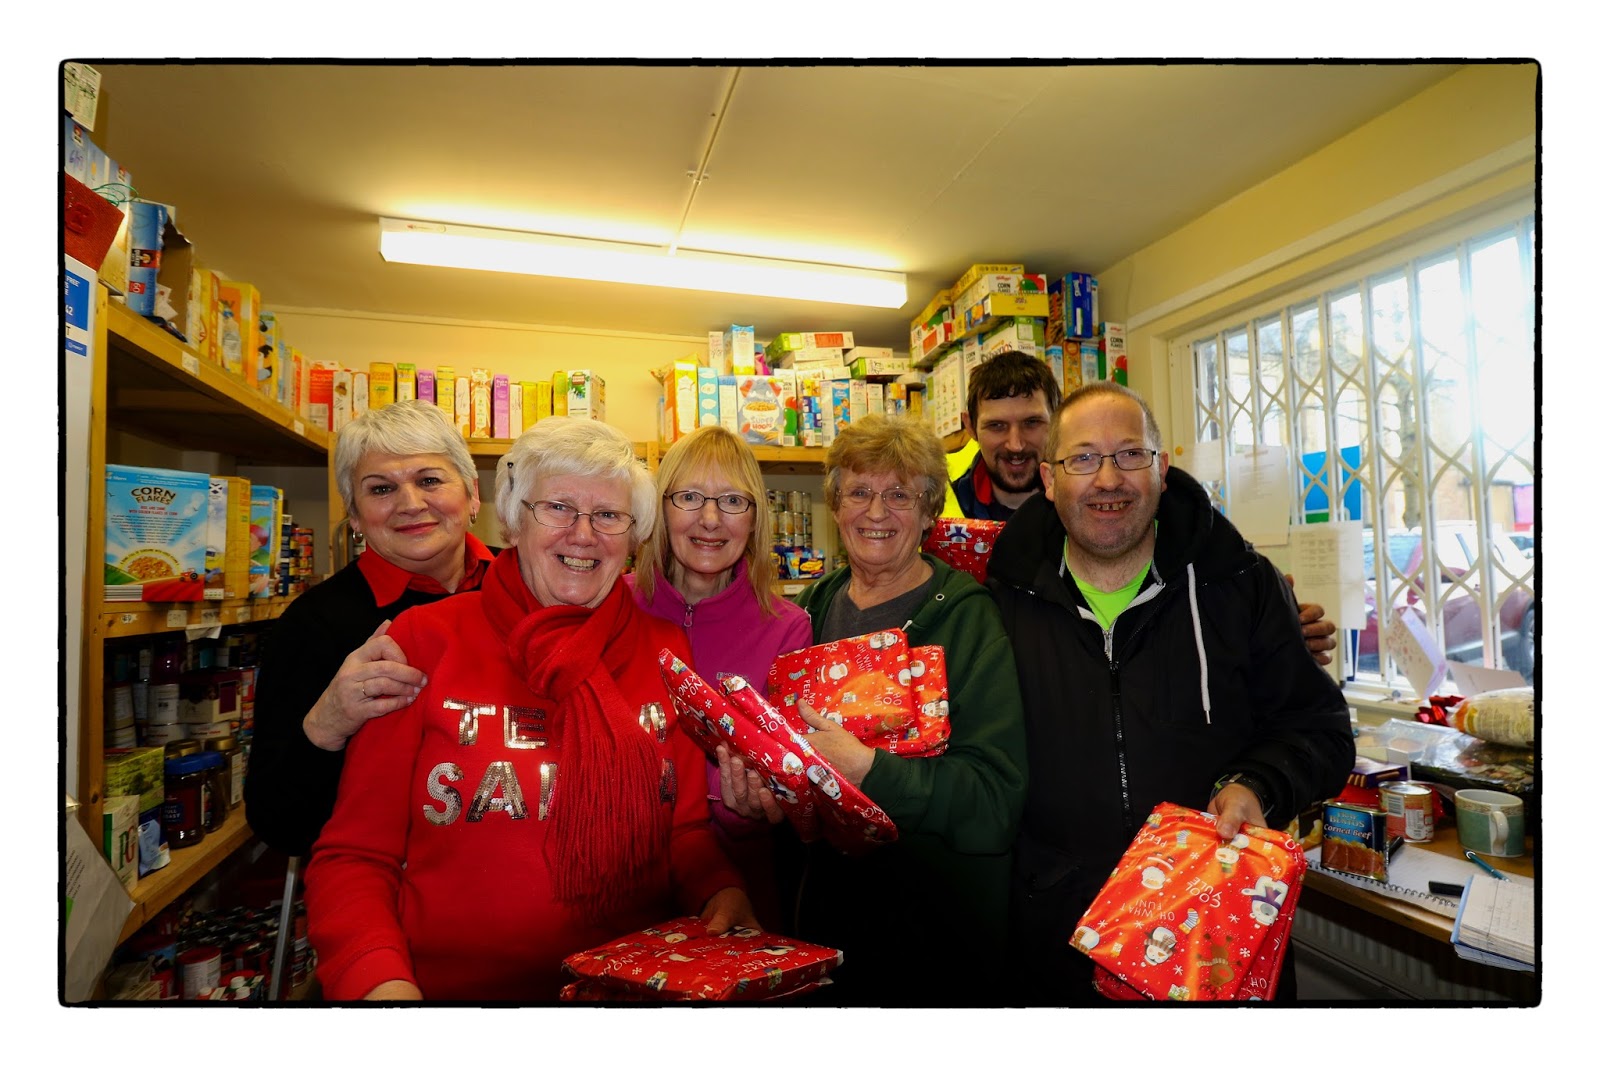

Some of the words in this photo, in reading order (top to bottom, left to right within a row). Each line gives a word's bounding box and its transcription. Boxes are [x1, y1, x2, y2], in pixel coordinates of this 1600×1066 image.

[1110, 336, 1124, 344] CORN
[130, 486, 177, 501] CORN
[135, 495, 173, 505] FLAKES
[689, 680, 703, 697] NO
[883, 686, 894, 706] HO
[873, 693, 882, 708] HO
[893, 689, 903, 707] HO
[1329, 815, 1366, 829] BENTOS
[1323, 823, 1352, 837] Corned
[1353, 829, 1374, 841] Beef
[1184, 881, 1222, 910] COOL
[1192, 876, 1222, 900] YULE
[1120, 903, 1158, 921] WHAT
[1135, 900, 1163, 912] FUN!
[1159, 909, 1176, 922] OH
